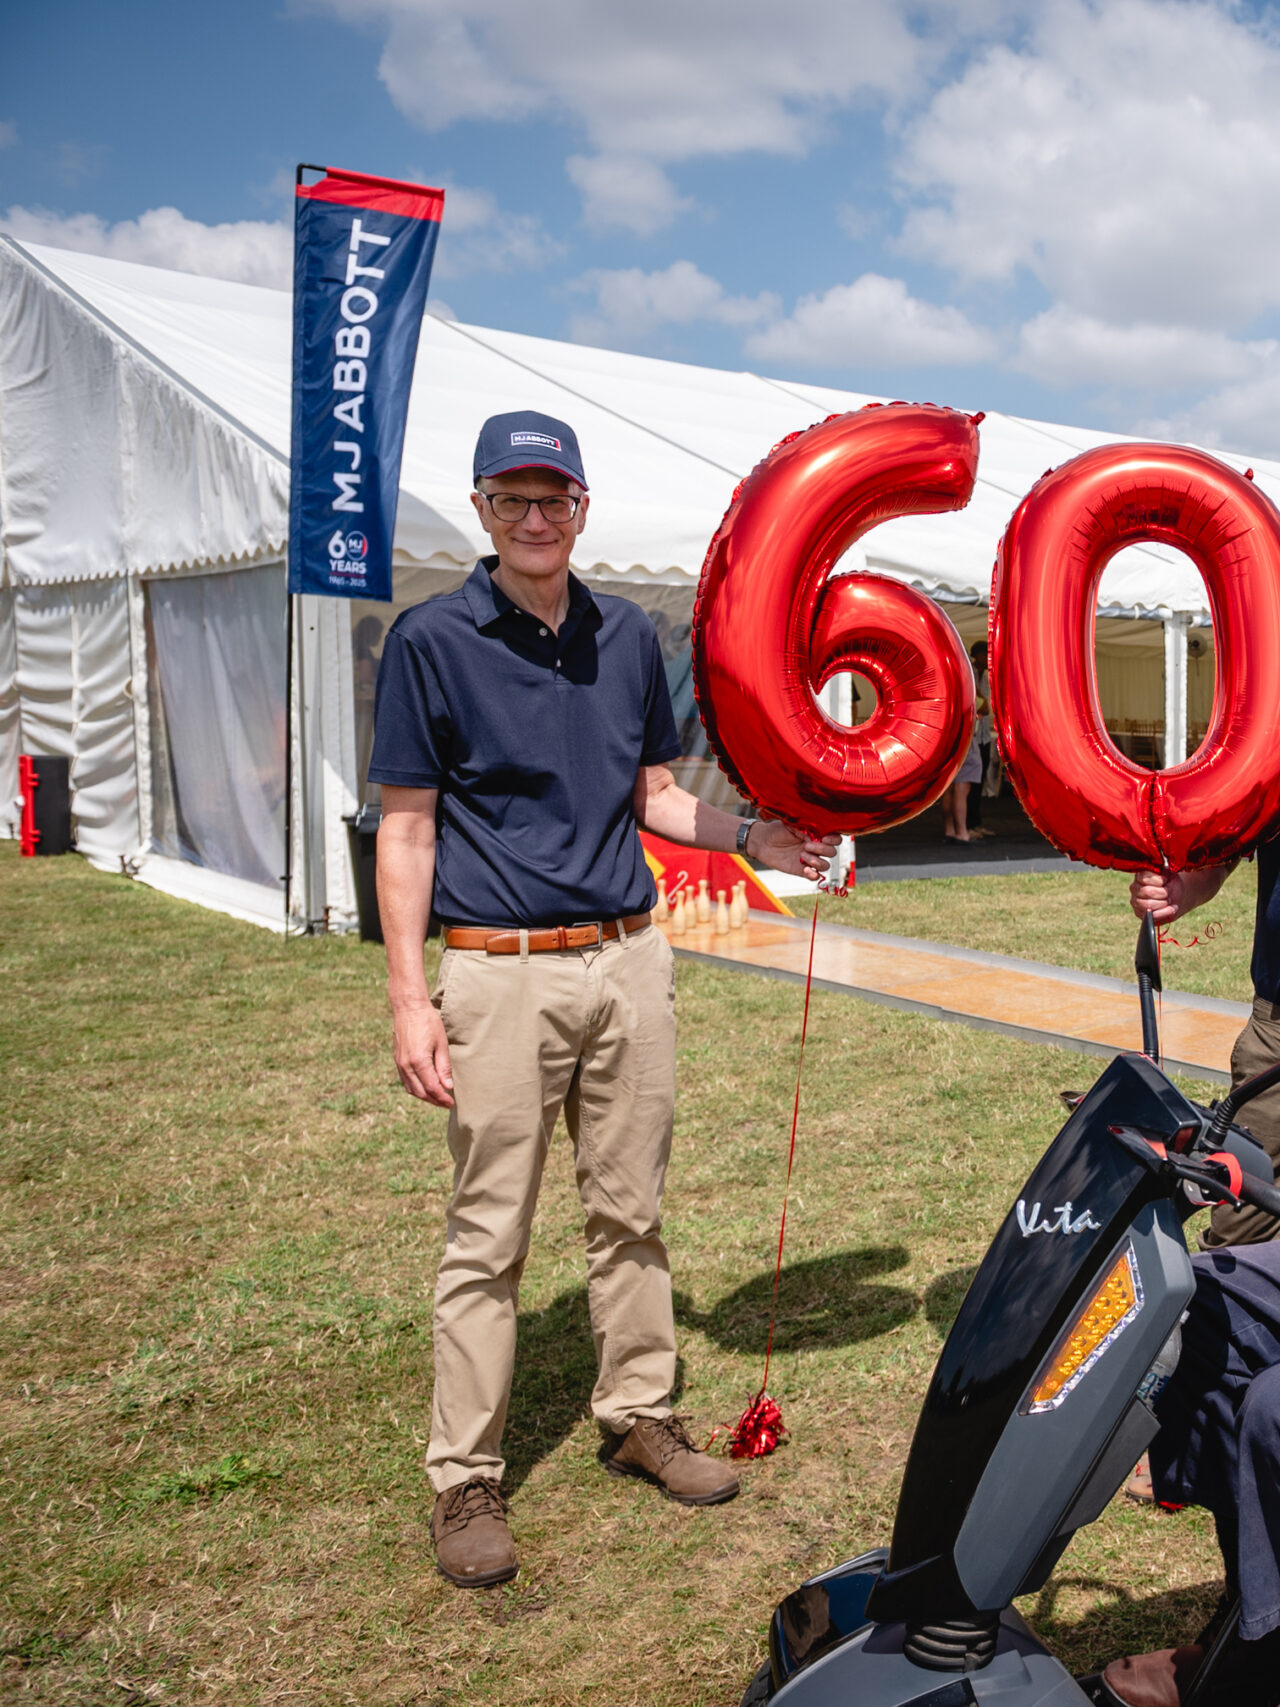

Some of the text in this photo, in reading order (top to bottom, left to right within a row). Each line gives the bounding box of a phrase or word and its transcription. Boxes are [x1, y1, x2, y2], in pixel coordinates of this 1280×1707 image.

[332, 218, 391, 513] MJ ABBOTT
[526, 435, 555, 446] ABBOTT
[329, 559, 367, 574] YEARS
[1016, 1199, 1101, 1238] Vita
